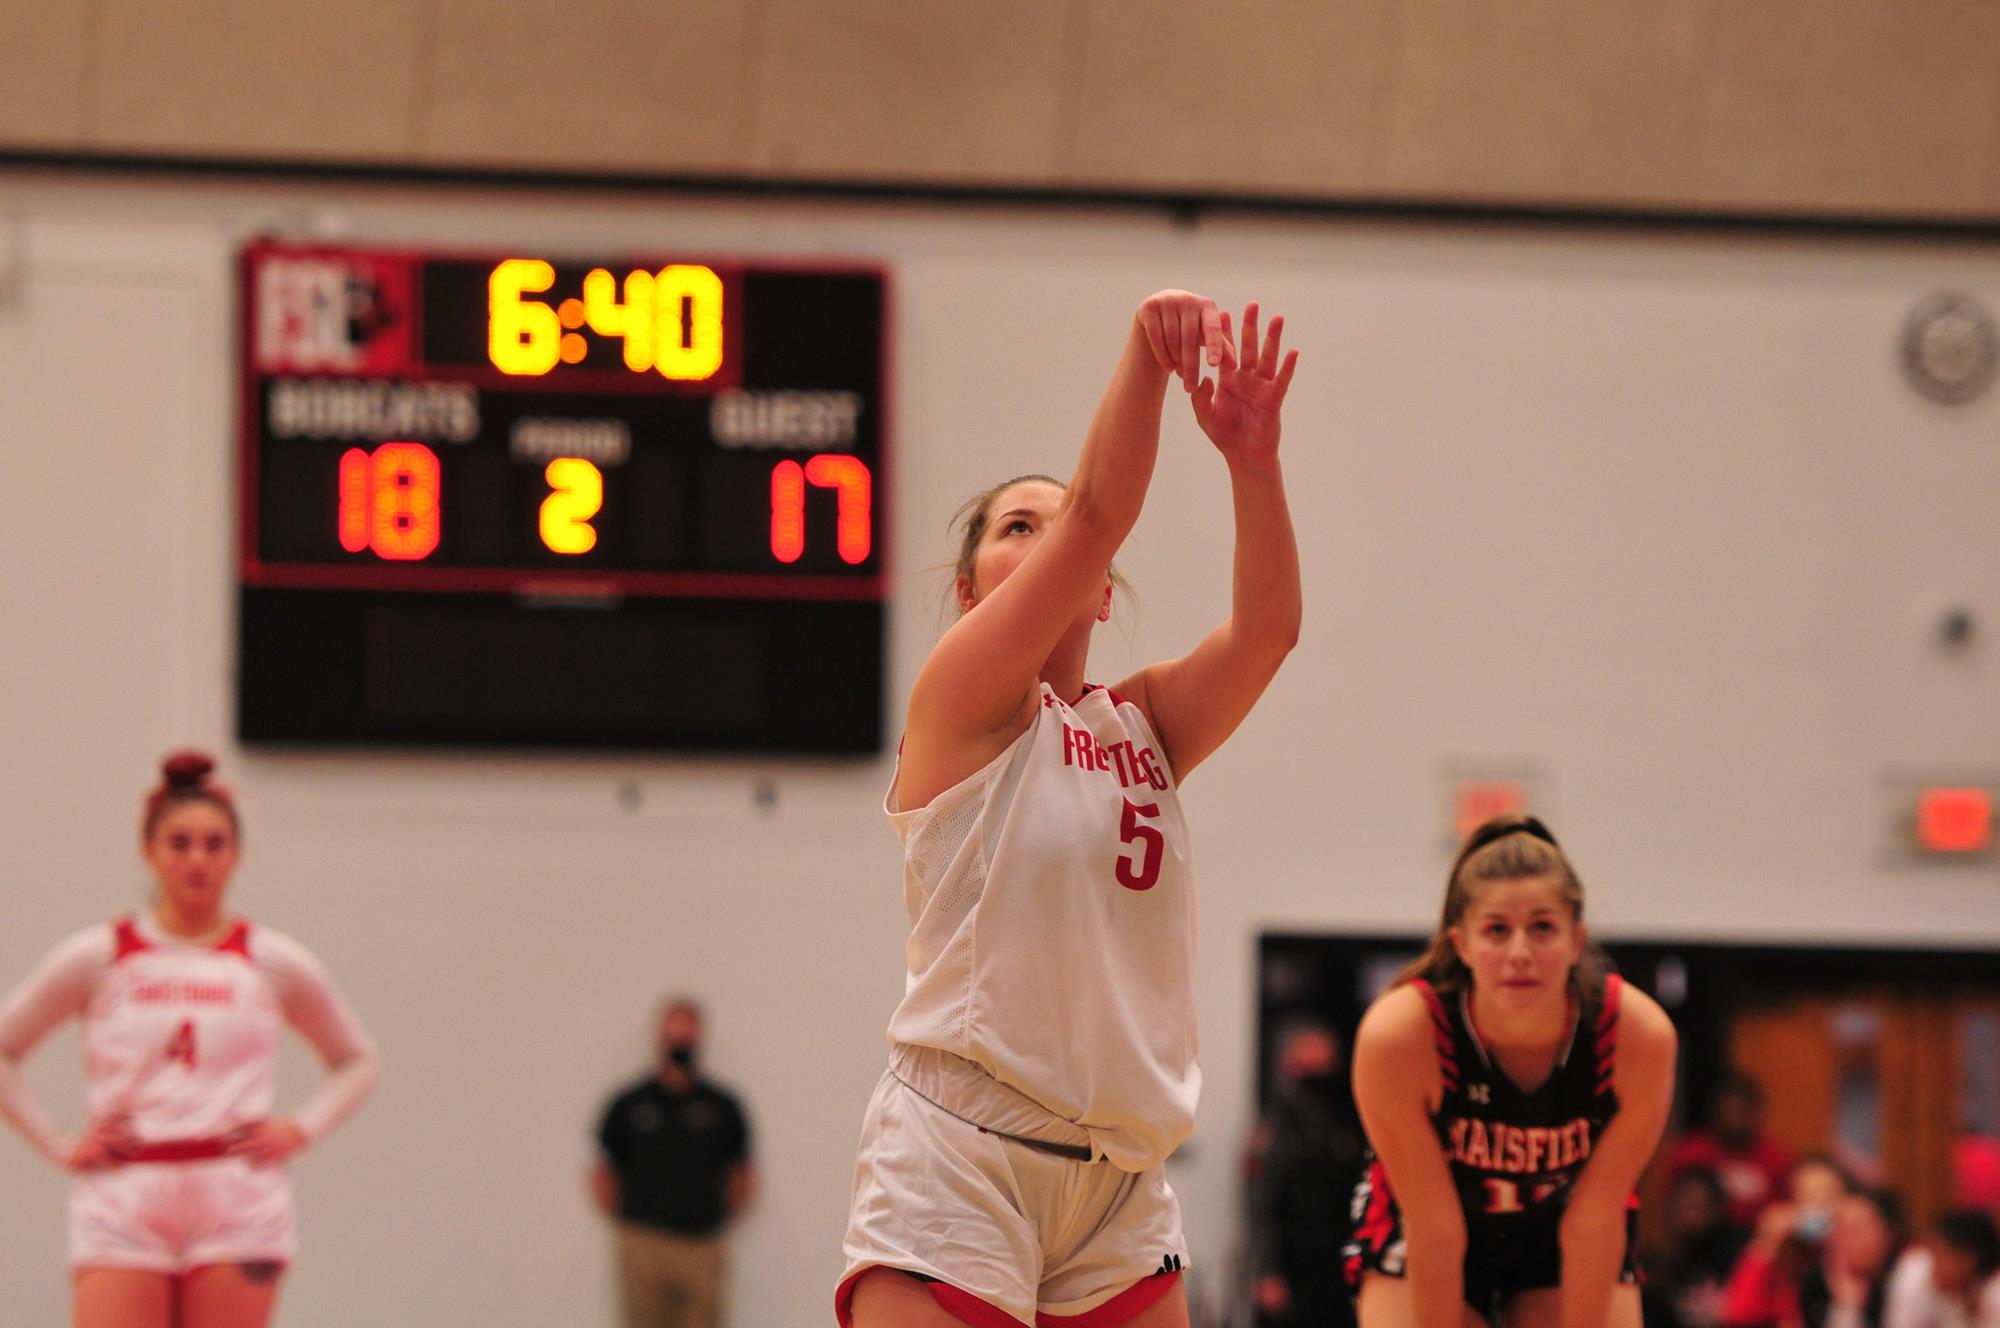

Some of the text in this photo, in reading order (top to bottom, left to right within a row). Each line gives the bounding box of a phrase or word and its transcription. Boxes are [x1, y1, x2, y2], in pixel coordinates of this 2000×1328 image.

[488, 259, 723, 380] 6:40
[712, 389, 864, 448] GUEST
[339, 442, 441, 561] 18
[539, 457, 603, 554] 2
[770, 454, 872, 564] 17
[1115, 795, 1164, 891] 5
[166, 1020, 198, 1071] 4
